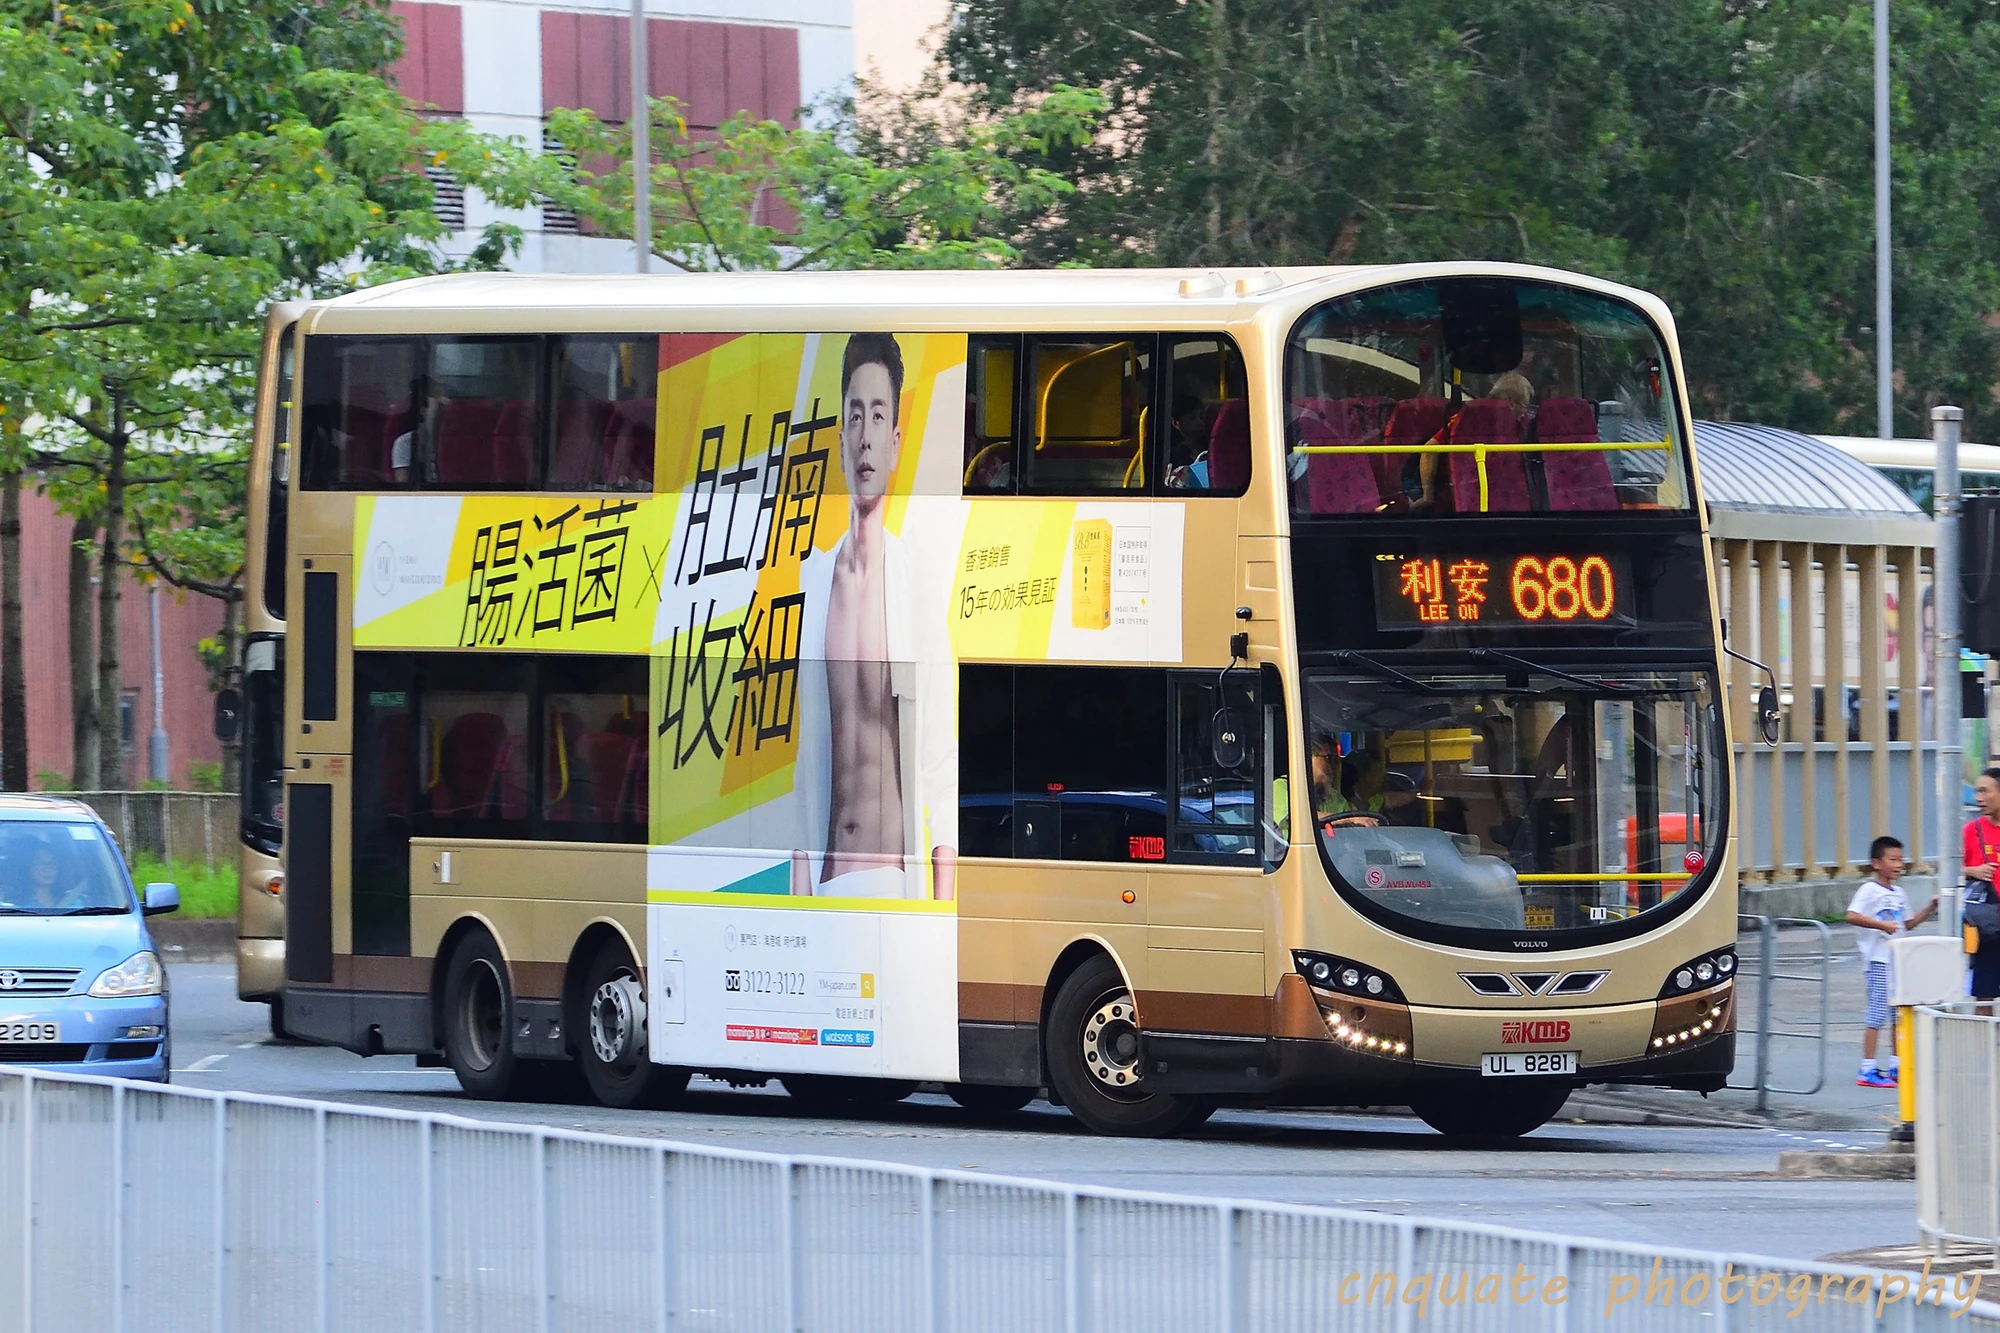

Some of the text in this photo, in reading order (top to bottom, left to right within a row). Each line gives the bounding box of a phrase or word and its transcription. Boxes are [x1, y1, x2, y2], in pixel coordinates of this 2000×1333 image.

[674, 398, 837, 587] 肚腩
[965, 544, 1011, 572] 香港銷售
[459, 498, 638, 647] 腸活菌
[1400, 558, 1489, 603] 利安
[1512, 555, 1614, 620] 680
[1420, 604, 1478, 621] LEE ON
[658, 590, 806, 770] 收細
[1513, 940, 1548, 948] VOLVO
[744, 970, 805, 995] 3122-3122
[0, 1024, 55, 1040] 2209
[824, 1031, 853, 1043] watsons
[1521, 1021, 1571, 1043] KMB
[1490, 1054, 1568, 1073] UL 8281
